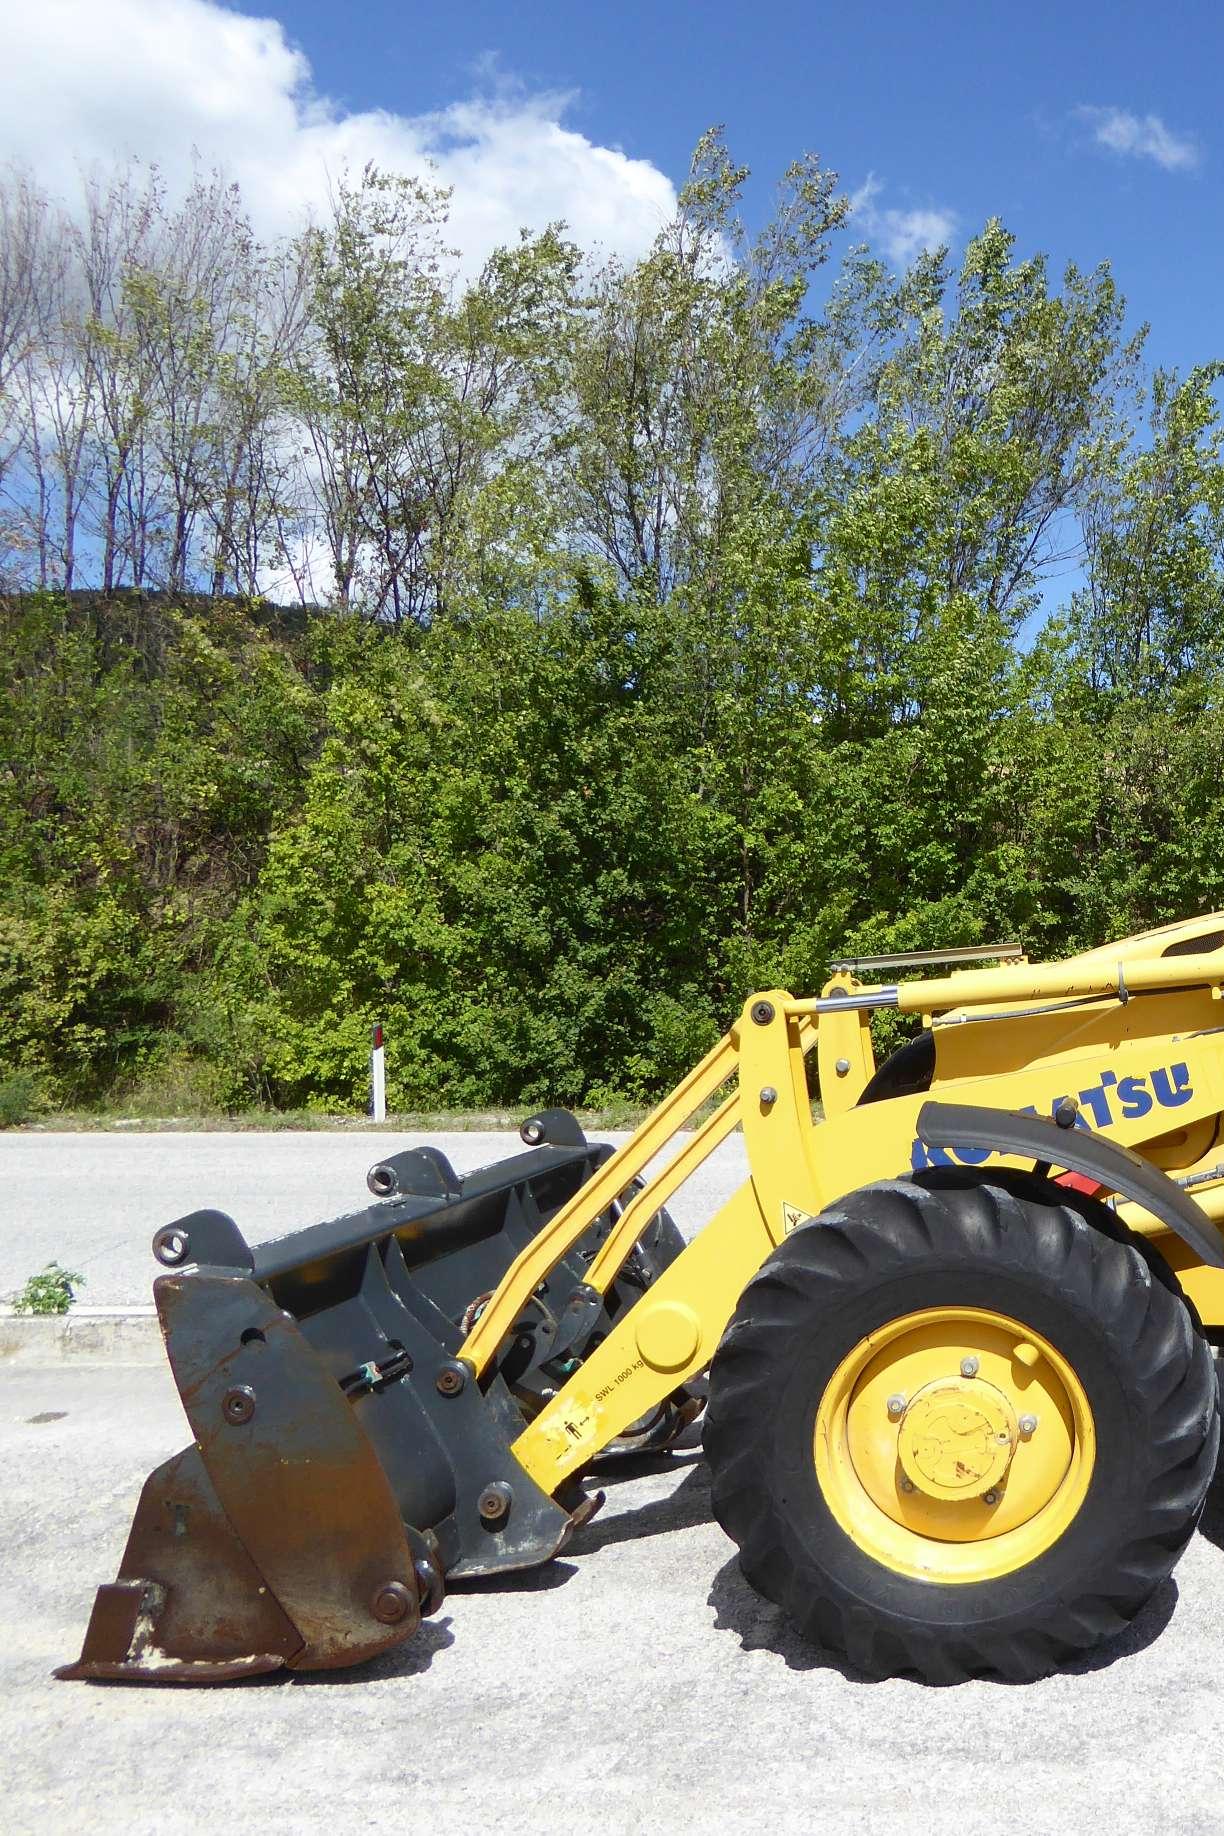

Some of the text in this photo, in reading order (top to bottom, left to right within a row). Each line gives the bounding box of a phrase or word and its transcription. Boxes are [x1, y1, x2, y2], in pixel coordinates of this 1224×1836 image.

[595, 1359, 645, 1402] SWL 1000 kg
